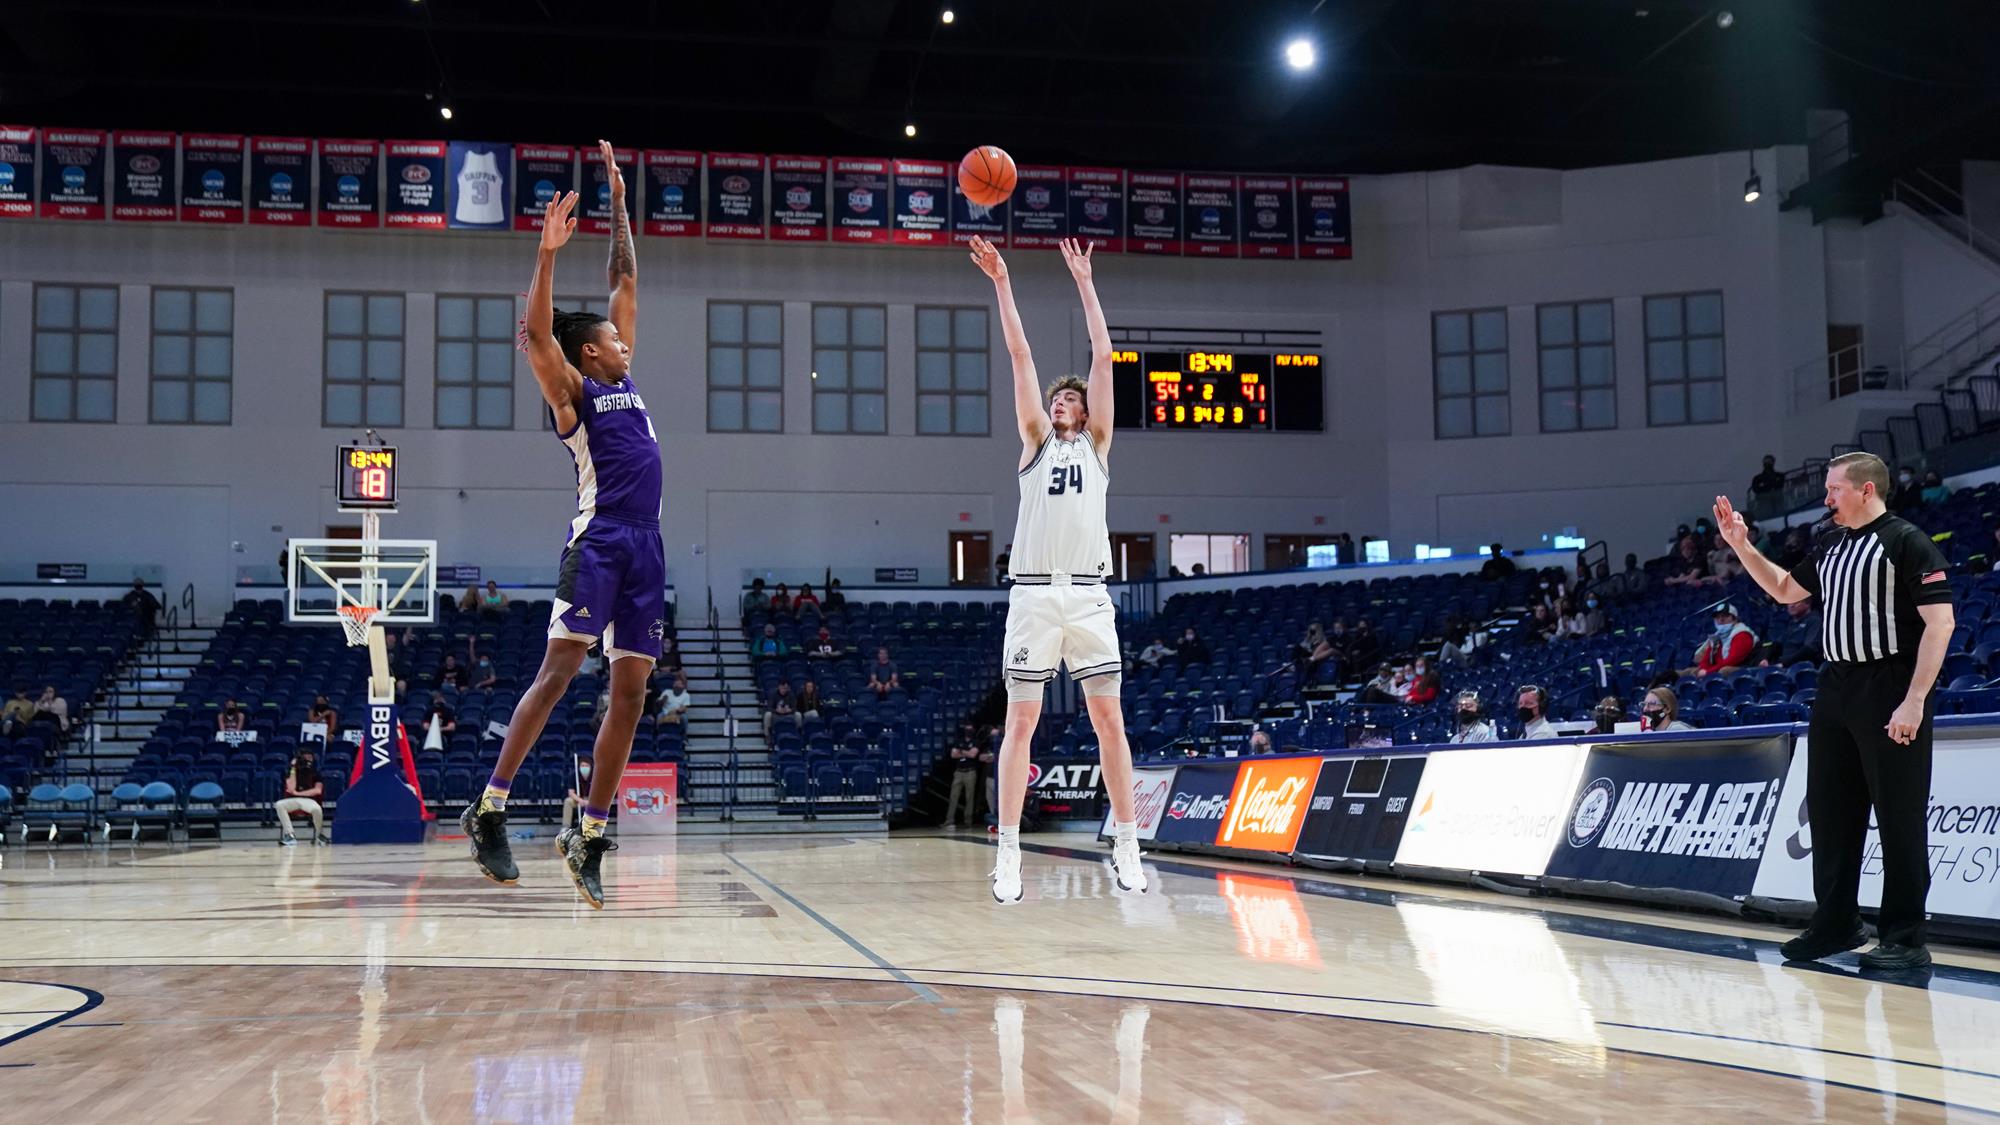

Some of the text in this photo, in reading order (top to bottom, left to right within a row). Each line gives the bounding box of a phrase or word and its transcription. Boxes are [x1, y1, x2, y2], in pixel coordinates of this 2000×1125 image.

[391, 145, 440, 155] SAMFORD
[522, 149, 569, 160] SAMFORD
[464, 171, 498, 184] GRIFFIN
[472, 180, 489, 206] 3
[1189, 352, 1233, 373] 13:44
[1156, 382, 1180, 401] 54
[1202, 383, 1214, 401] 2
[1241, 384, 1266, 402] 41
[593, 392, 632, 413] WESTERN
[1155, 405, 1167, 422] 5
[1174, 405, 1186, 423] 3
[1213, 406, 1225, 423] 2
[1232, 406, 1244, 424] 3
[1258, 407, 1266, 423] 1
[351, 450, 392, 469] 13:44
[361, 468, 387, 498] 18
[1048, 464, 1083, 495] 34
[371, 706, 391, 770] BBVA
[1038, 765, 1102, 788] ATI
[1053, 790, 1097, 800] THERAPY
[1614, 782, 1691, 826] MAKE
[1681, 783, 1710, 827] A
[1703, 781, 1768, 827] GIFT
[1184, 794, 1230, 820] AmFirs
[1385, 797, 1407, 813] GUEST
[1508, 804, 1556, 839] Power
[1927, 796, 2000, 835] incent
[1598, 822, 1769, 860] MAKE A DIFFERENCE
